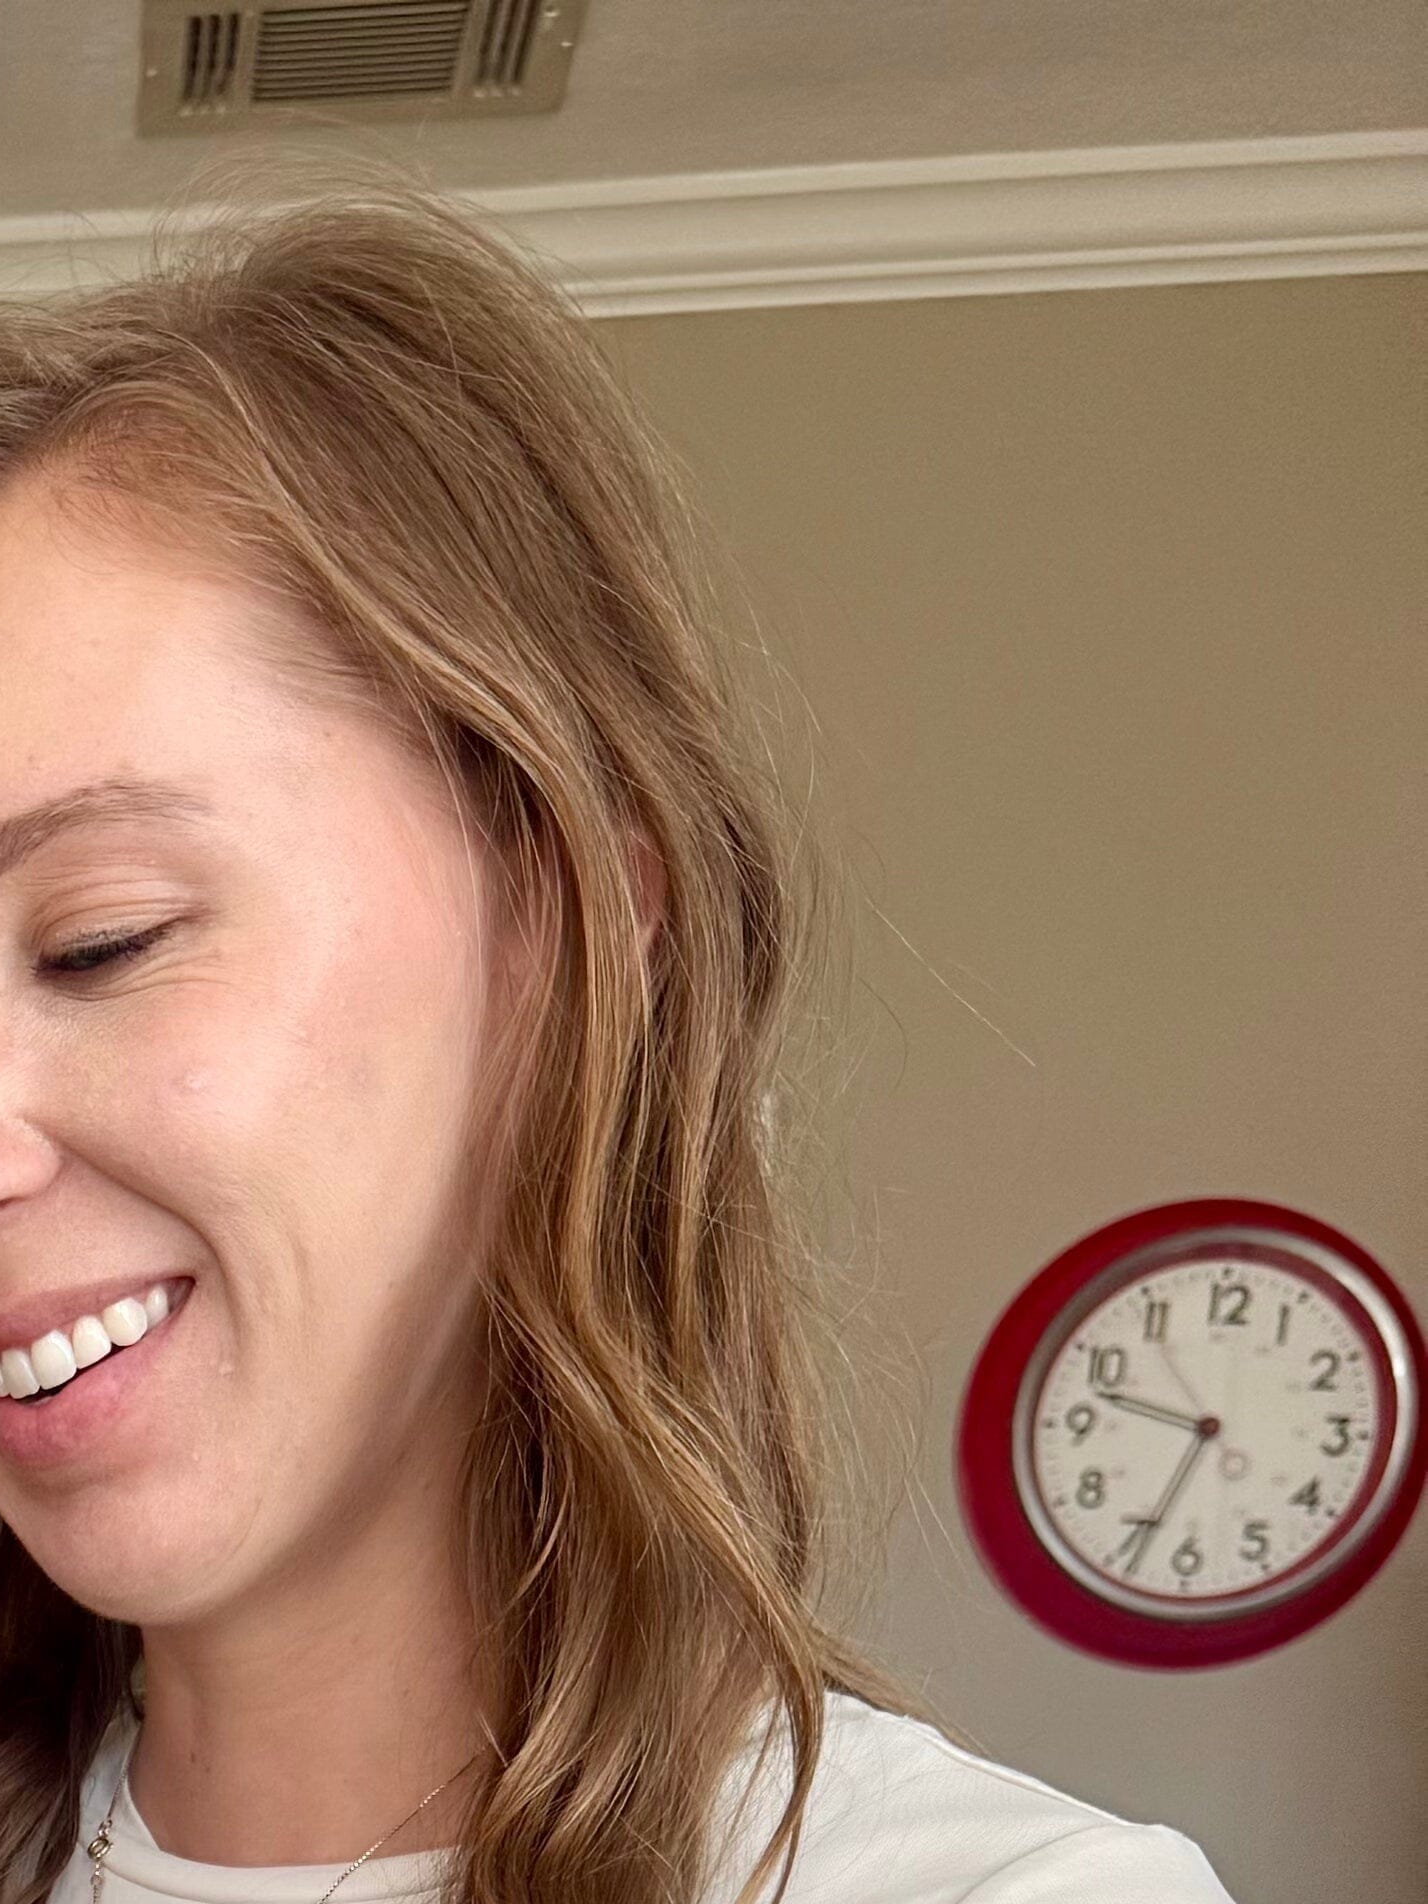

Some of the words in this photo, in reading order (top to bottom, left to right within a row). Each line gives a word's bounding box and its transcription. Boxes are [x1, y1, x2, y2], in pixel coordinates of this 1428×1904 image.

[1144, 1300, 1169, 1343] 11
[1207, 1284, 1250, 1326] 12
[1276, 1305, 1290, 1347] 1
[1087, 1347, 1128, 1388] 10
[1309, 1351, 1341, 1392] 2
[1066, 1405, 1097, 1446] 9
[1321, 1415, 1351, 1457] 3
[1076, 1468, 1105, 1509] 8
[1288, 1478, 1321, 1511] 4
[1120, 1514, 1159, 1558] 7
[1241, 1522, 1271, 1562] 5
[1172, 1537, 1204, 1577] 6
